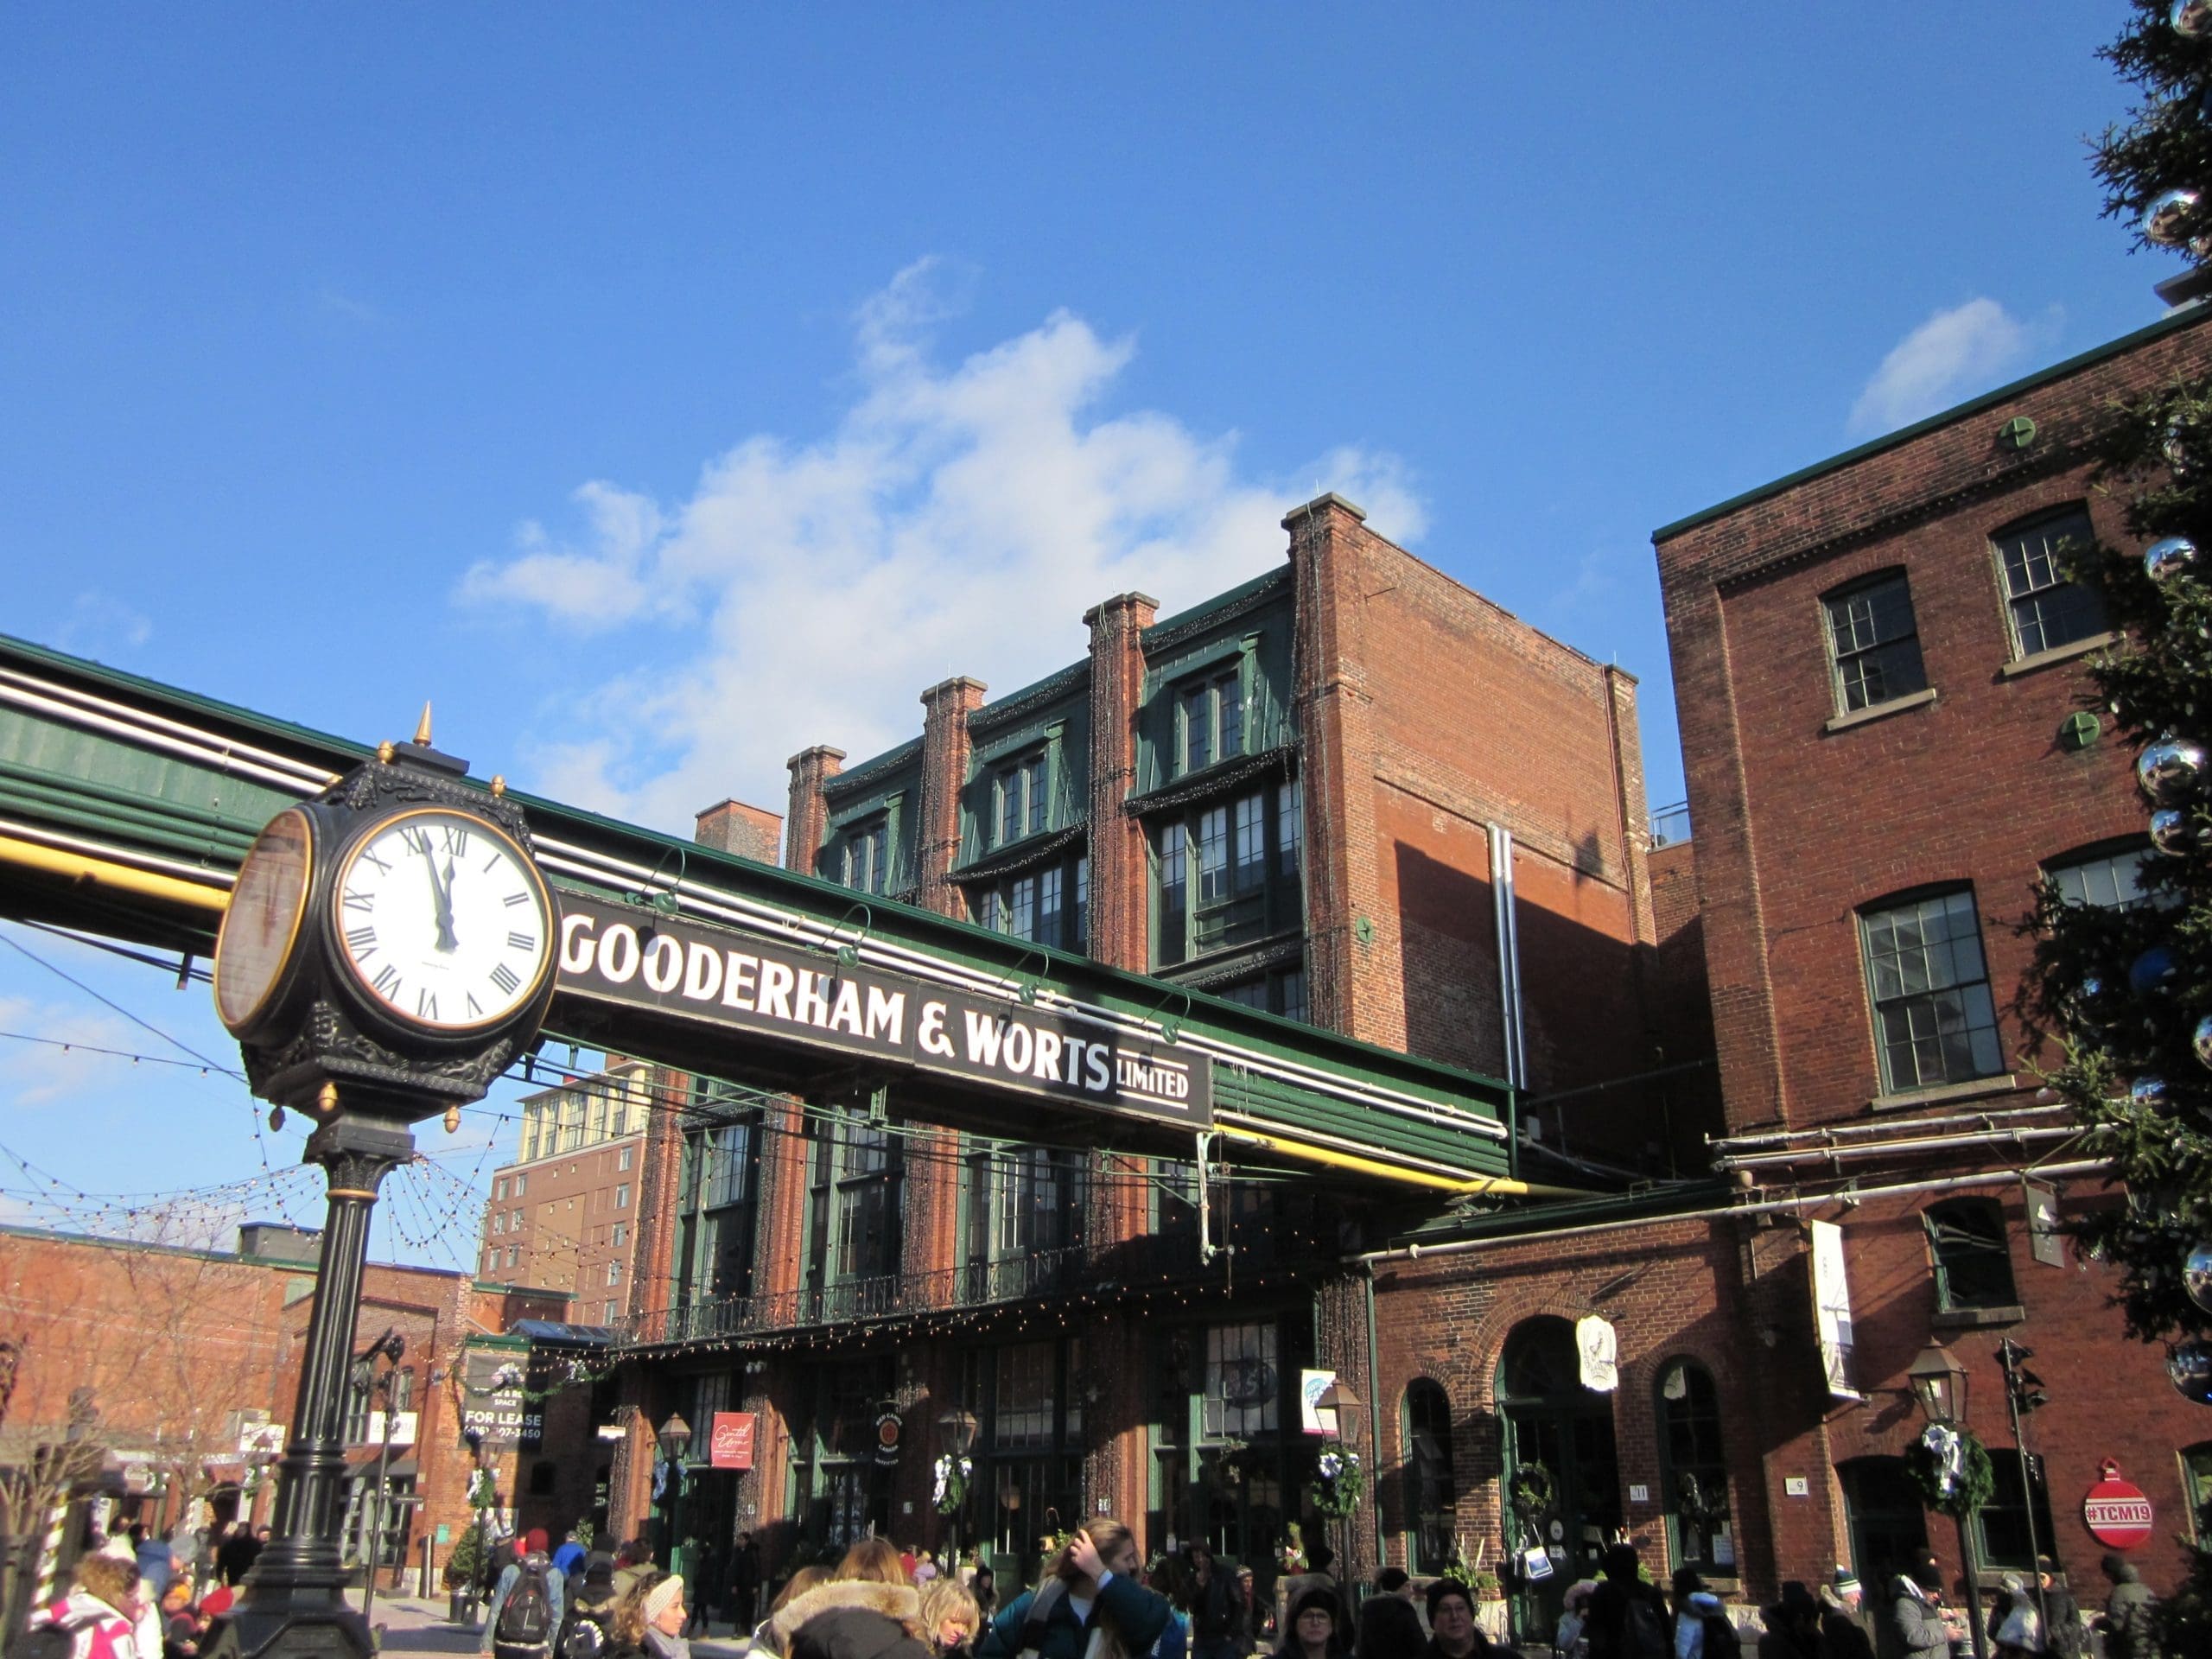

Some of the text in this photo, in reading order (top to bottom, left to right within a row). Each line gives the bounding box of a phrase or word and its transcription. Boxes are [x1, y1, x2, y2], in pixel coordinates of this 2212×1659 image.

[441, 824, 467, 858] XII
[360, 846, 393, 877] X
[483, 852, 501, 874] I
[343, 887, 375, 913] IX
[503, 891, 530, 908] II
[346, 926, 379, 964] VIII
[507, 931, 535, 952] III
[372, 963, 404, 1003] VII
[417, 987, 439, 1021] VI
[465, 989, 485, 1020] V
[559, 913, 1190, 1100] GOODERHAM & WORTS LIMITED
[494, 1398, 518, 1407] SPACE
[465, 1410, 542, 1427] FOR LEASE
[495, 1427, 541, 1439] 07-3450
[1796, 1480, 1804, 1492] 9
[2087, 1505, 2151, 1522] #TCM19
